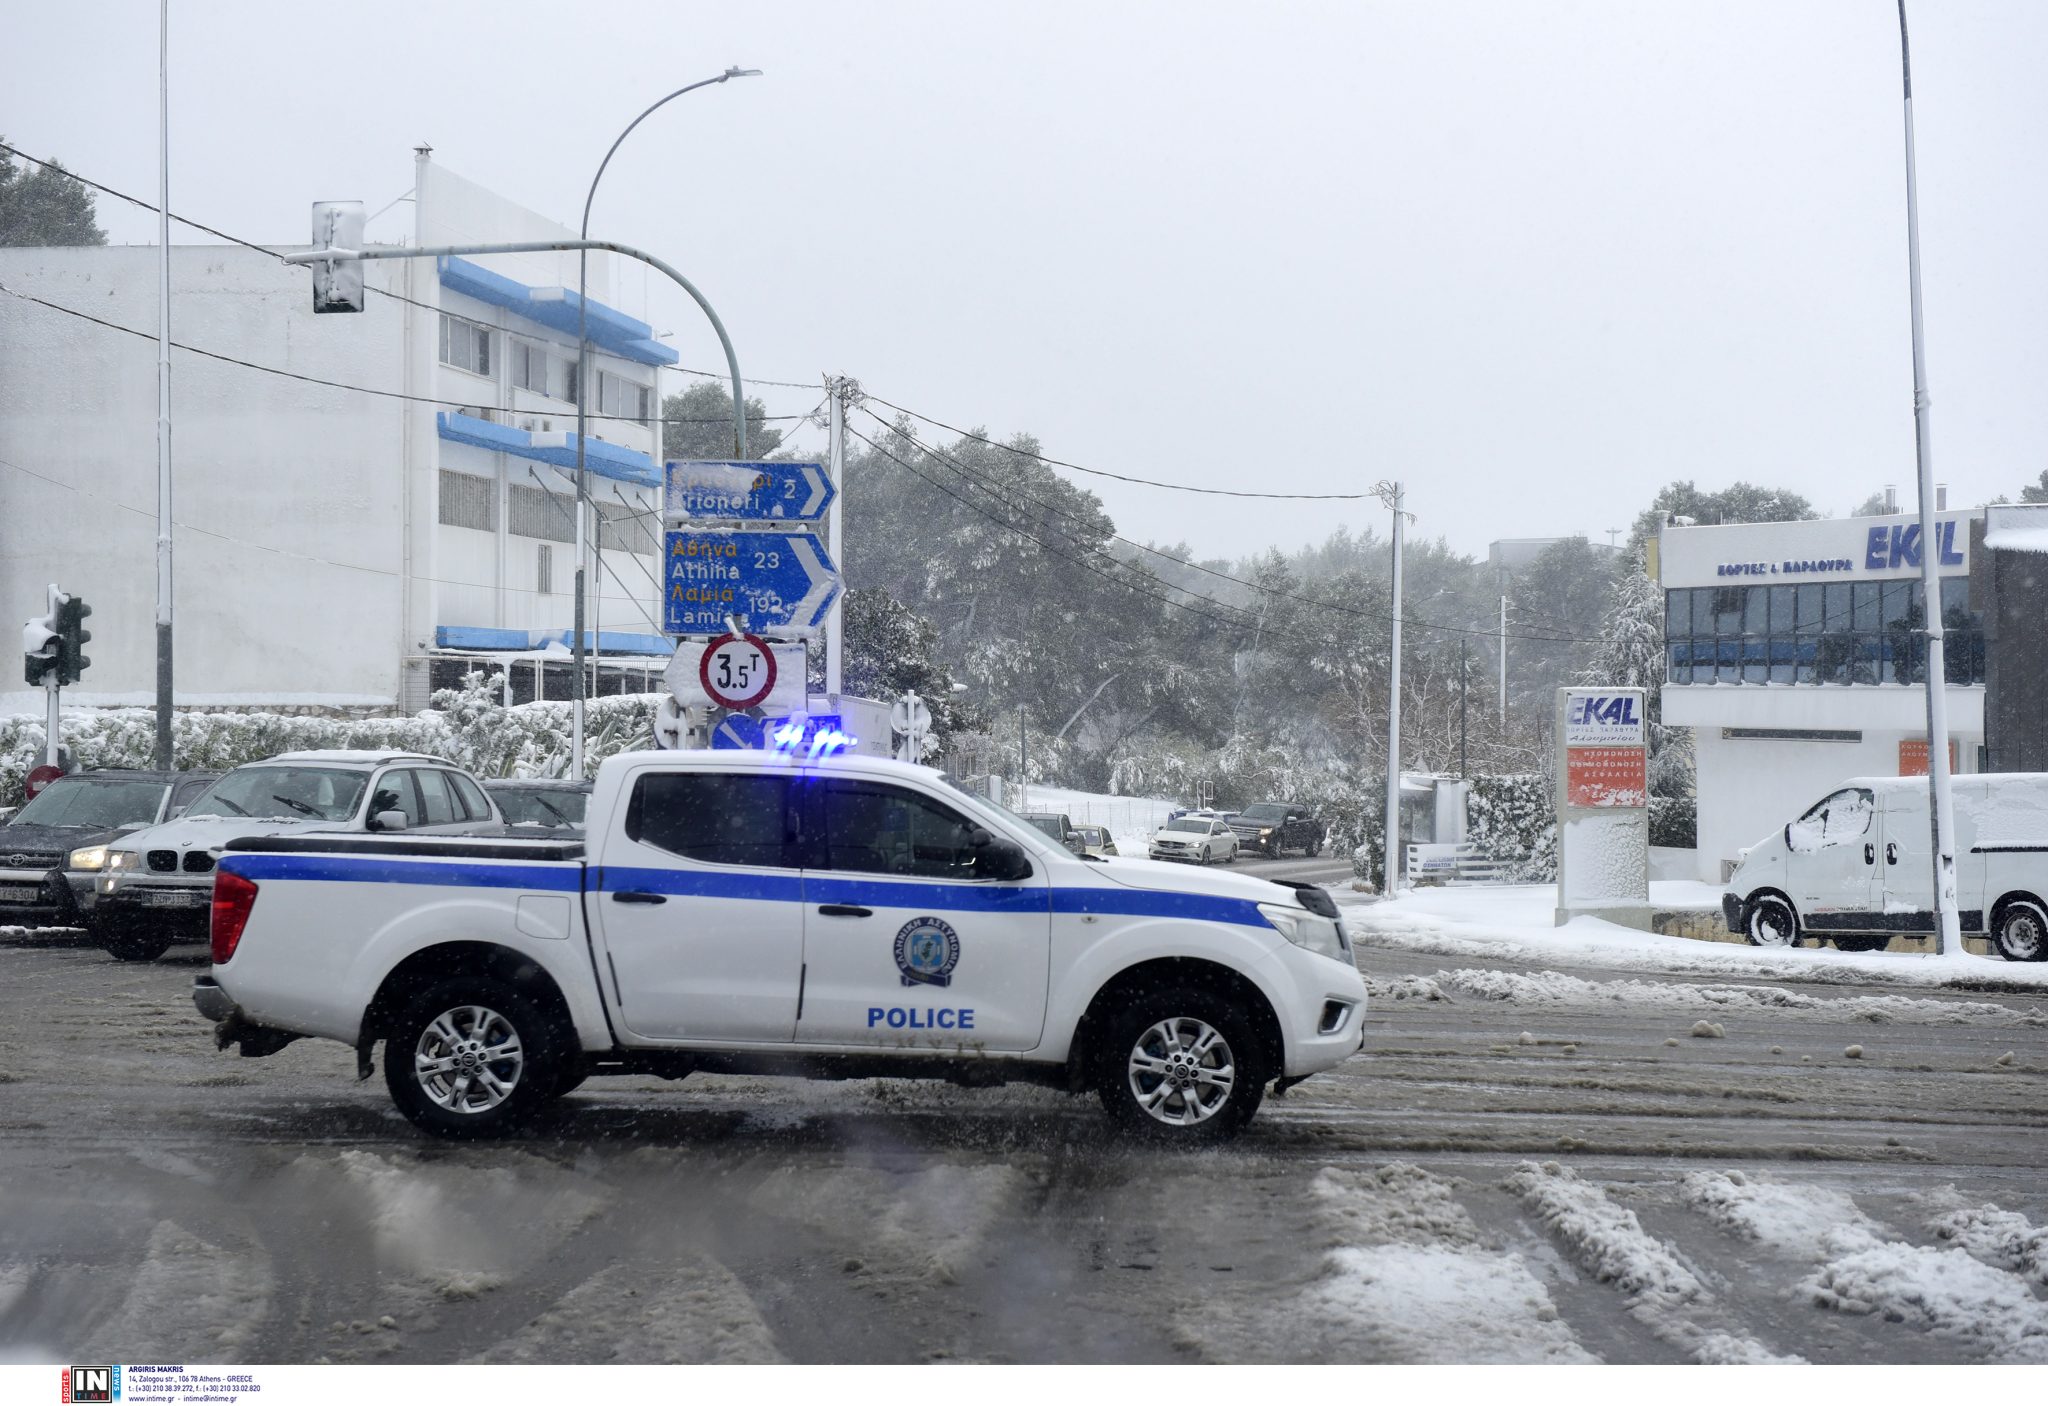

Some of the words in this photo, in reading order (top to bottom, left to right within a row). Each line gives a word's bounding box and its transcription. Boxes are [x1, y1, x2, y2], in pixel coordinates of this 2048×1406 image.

[674, 493, 759, 510] rioneri
[784, 483, 796, 499] 2
[672, 562, 740, 579] Athina
[754, 552, 779, 569] 23
[1567, 697, 1639, 725] EKAL
[927, 918, 959, 974] ΑΣΤΥΝΟΜΙΑ
[867, 1007, 975, 1029] POLICE
